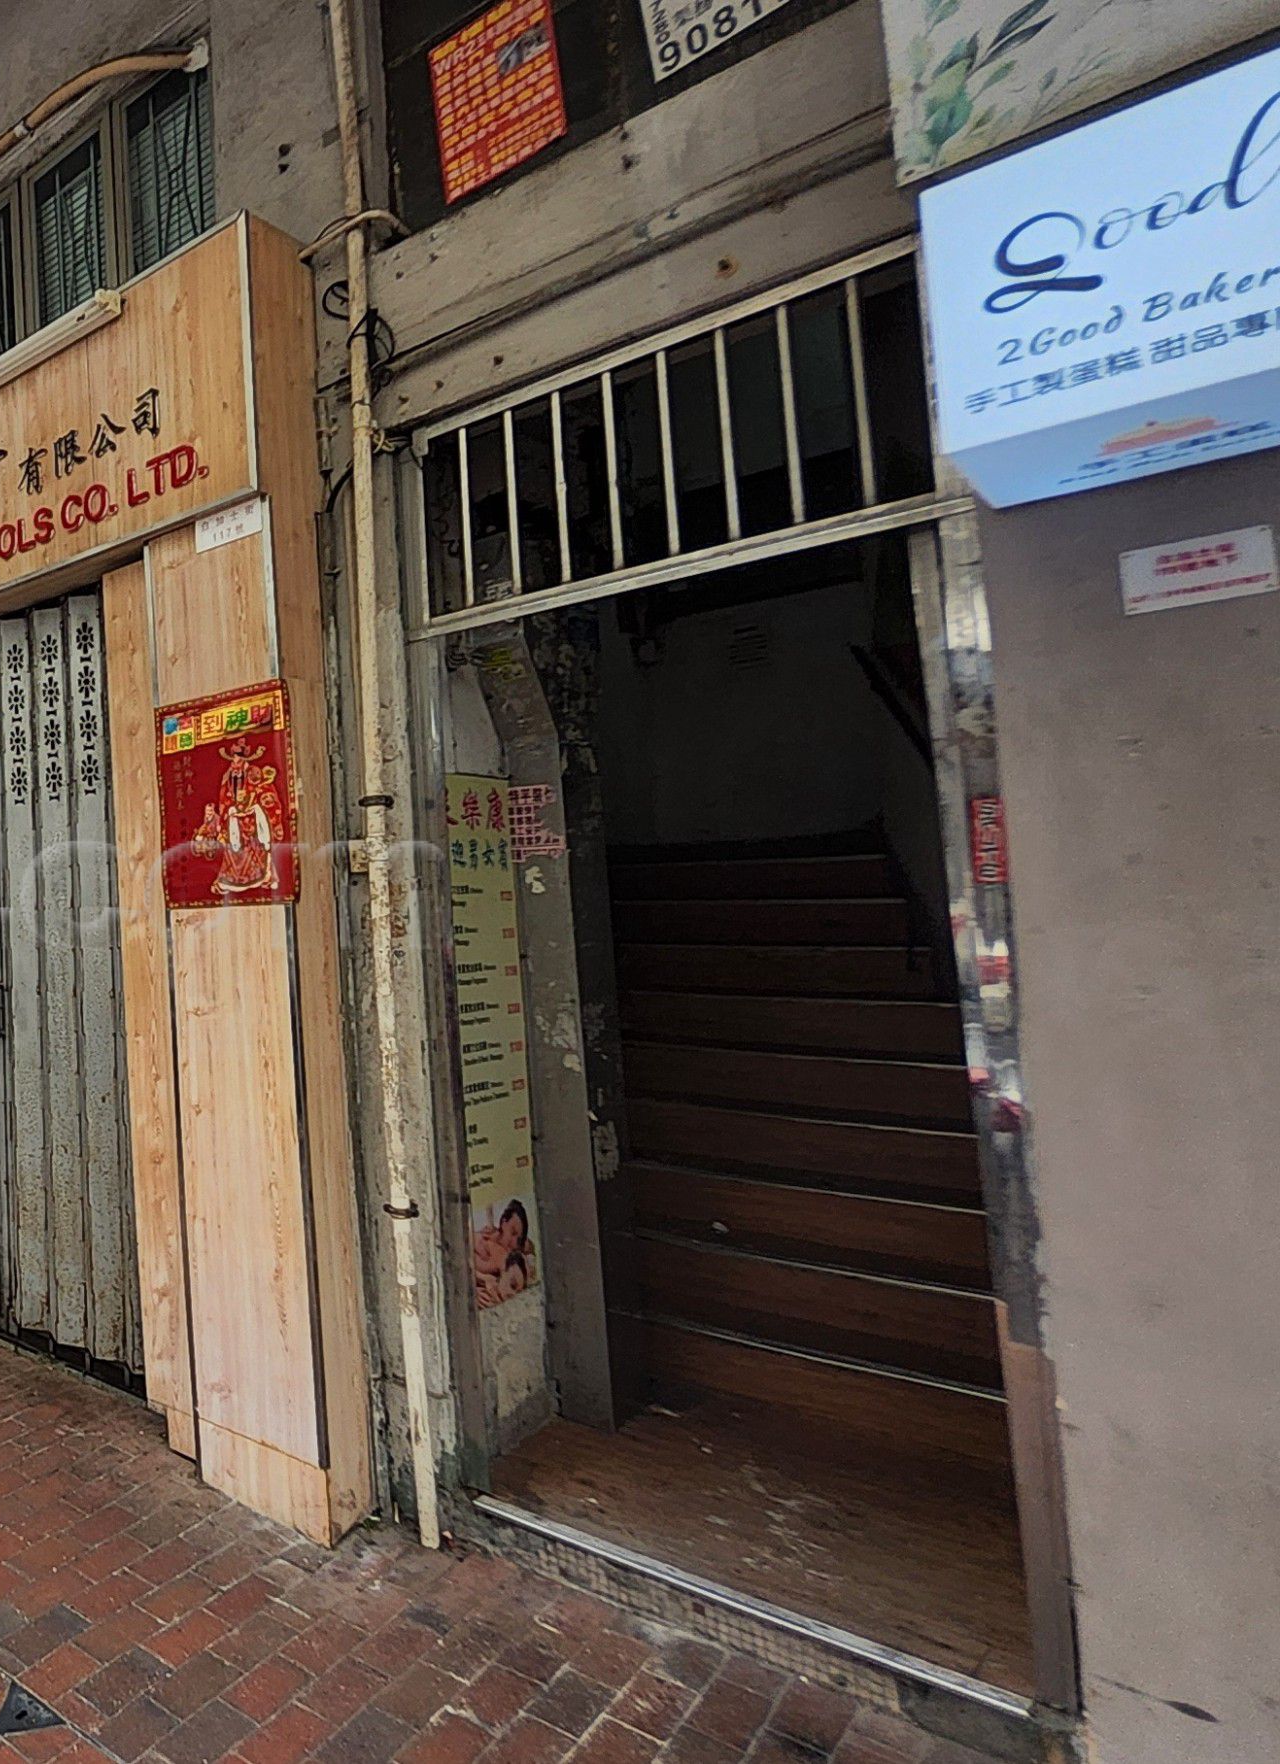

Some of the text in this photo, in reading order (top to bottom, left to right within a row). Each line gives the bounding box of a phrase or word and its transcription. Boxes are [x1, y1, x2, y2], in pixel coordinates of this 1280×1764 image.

[1149, 306, 1280, 364] 甜品專
[17, 387, 162, 494] 有限公司
[60, 484, 119, 534] CO.
[126, 441, 210, 508] LTD.
